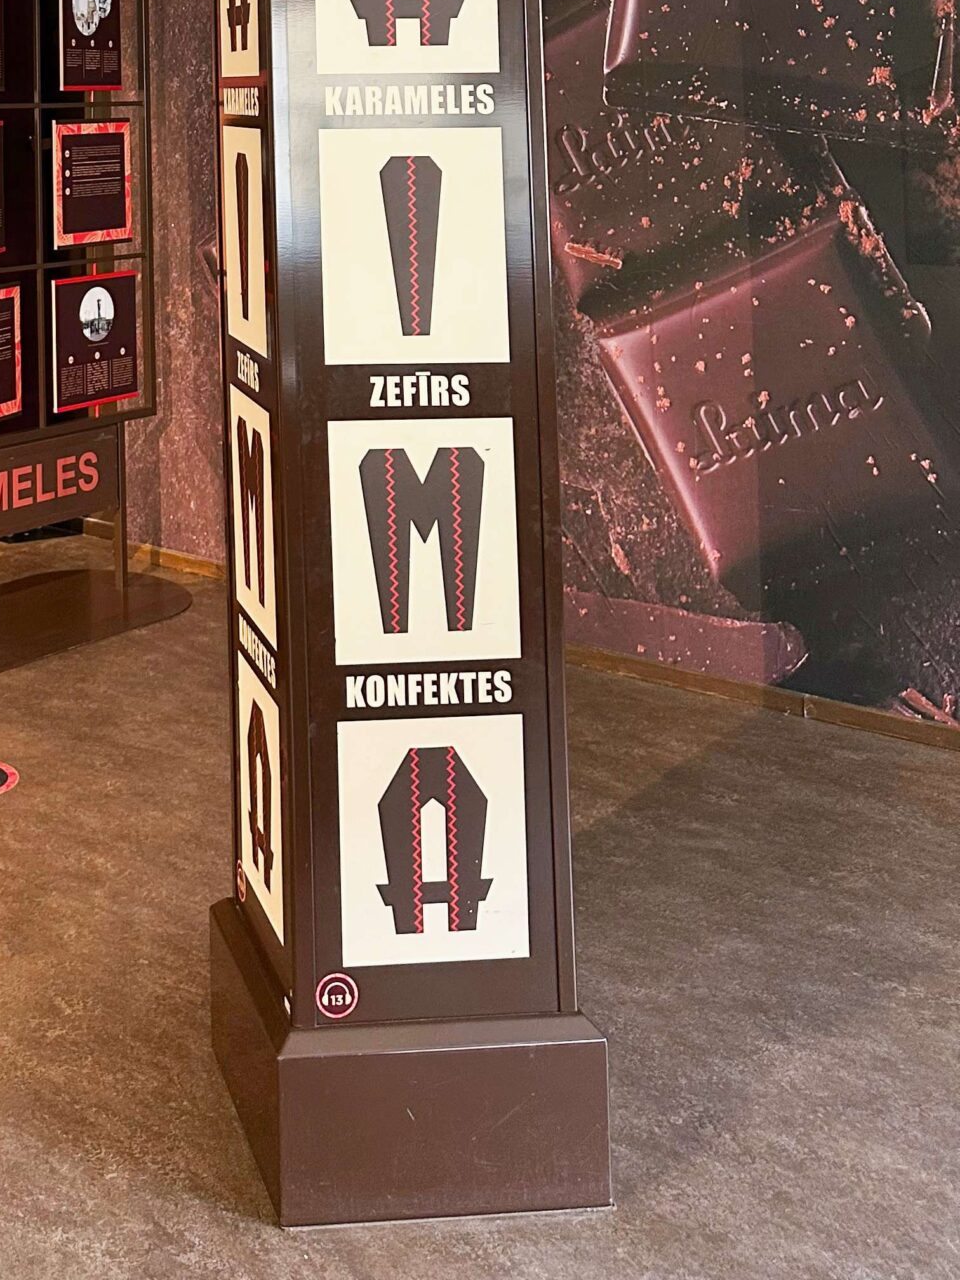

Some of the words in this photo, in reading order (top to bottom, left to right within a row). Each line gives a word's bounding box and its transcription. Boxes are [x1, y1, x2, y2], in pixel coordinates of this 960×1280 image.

[223, 87, 259, 117] KARAMELES
[325, 84, 495, 116] KARAMELES
[237, 350, 260, 393] ZEFĪRS
[369, 371, 470, 407] ZEFĪRS
[358, 447, 485, 634] M
[239, 613, 277, 689] KONFEKTES
[345, 670, 513, 708] KONFEKTES
[330, 995, 344, 1006] 13
